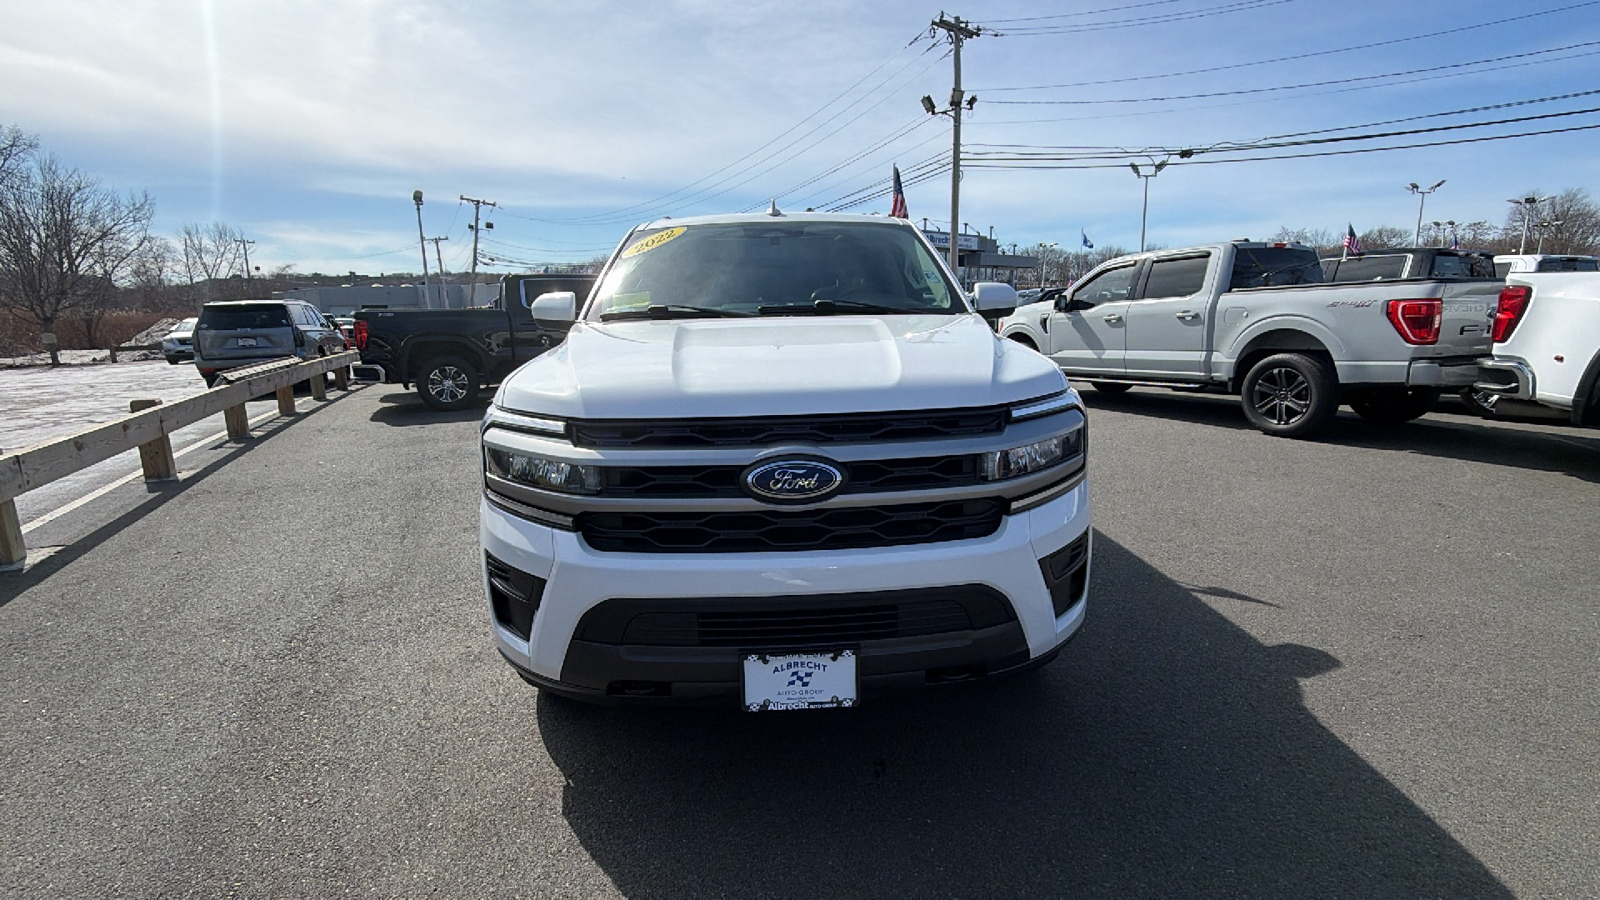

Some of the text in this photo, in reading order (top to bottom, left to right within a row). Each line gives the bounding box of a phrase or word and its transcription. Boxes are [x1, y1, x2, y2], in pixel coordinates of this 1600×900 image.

[634, 230, 676, 253] 2022
[1459, 324, 1492, 336] F-1
[769, 468, 819, 490] Ford
[772, 661, 828, 674] ALBRECHT
[768, 701, 809, 711] Albrecht
